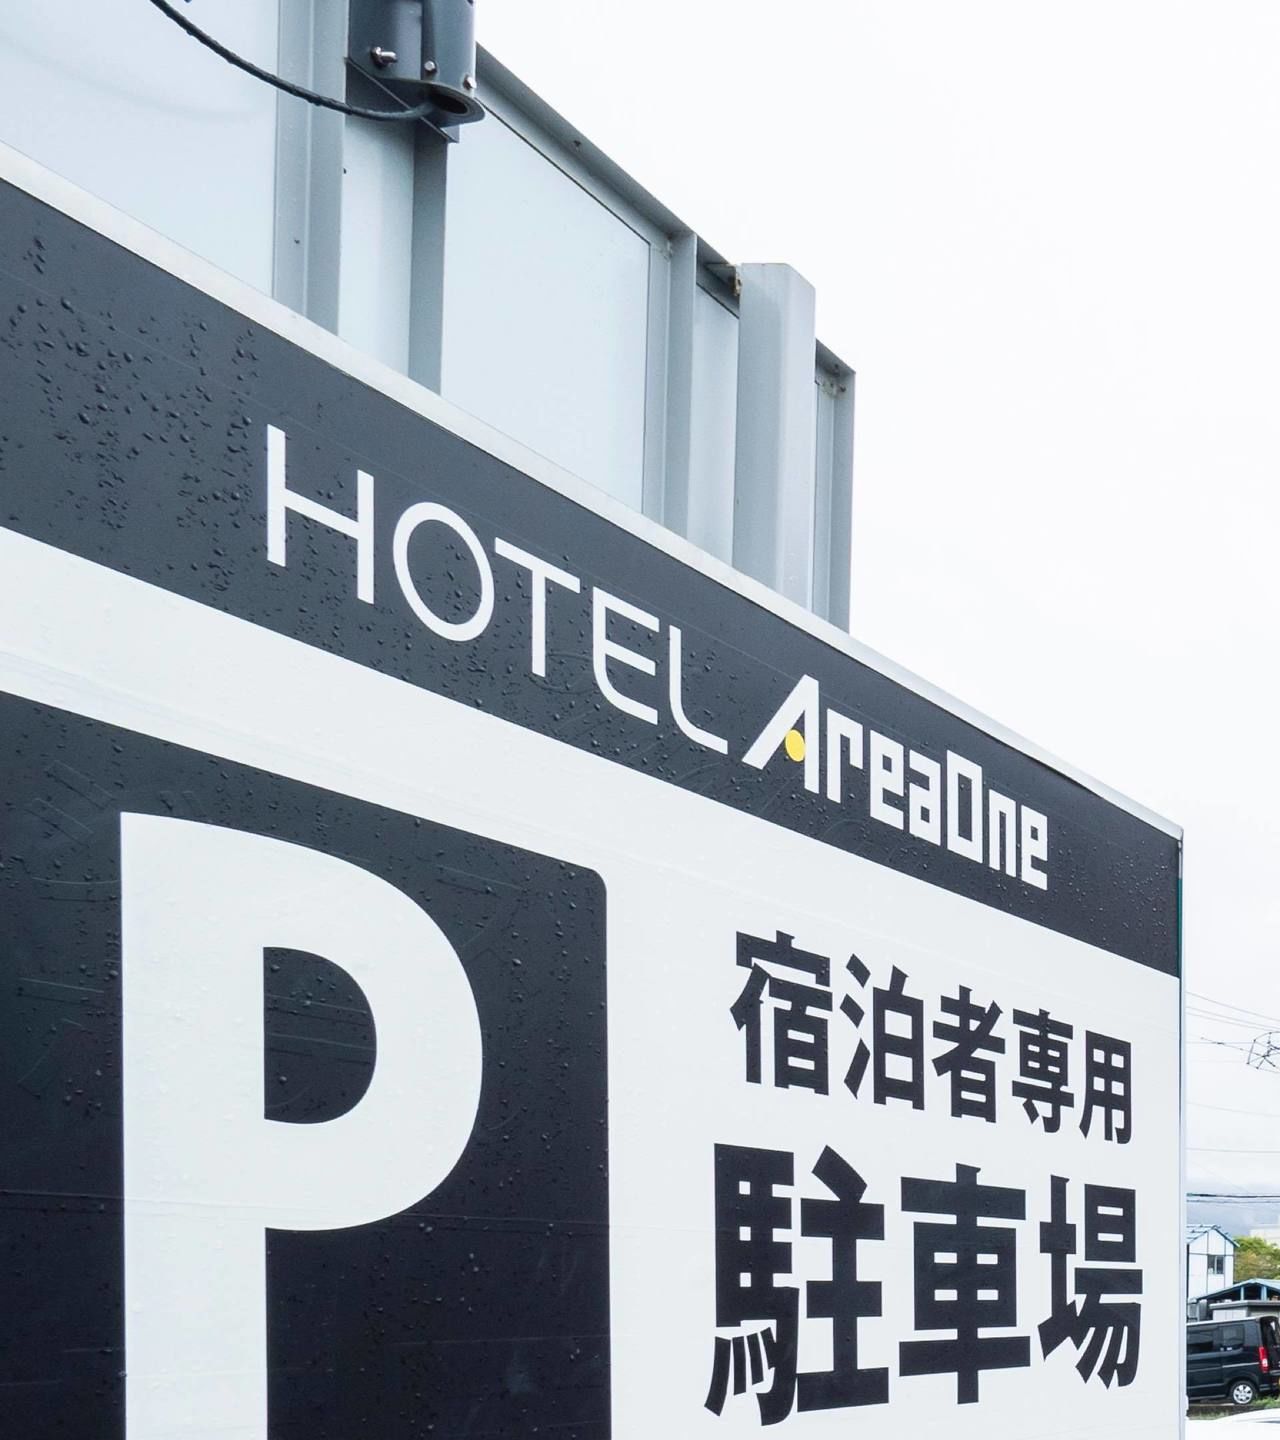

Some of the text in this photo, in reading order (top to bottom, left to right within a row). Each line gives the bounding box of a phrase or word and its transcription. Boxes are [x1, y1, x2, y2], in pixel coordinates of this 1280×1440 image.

[267, 424, 1048, 890] HOTEL AreaOne
[729, 929, 1134, 1146] 宿泊者専用
[703, 1142, 1144, 1427] 駐車場
